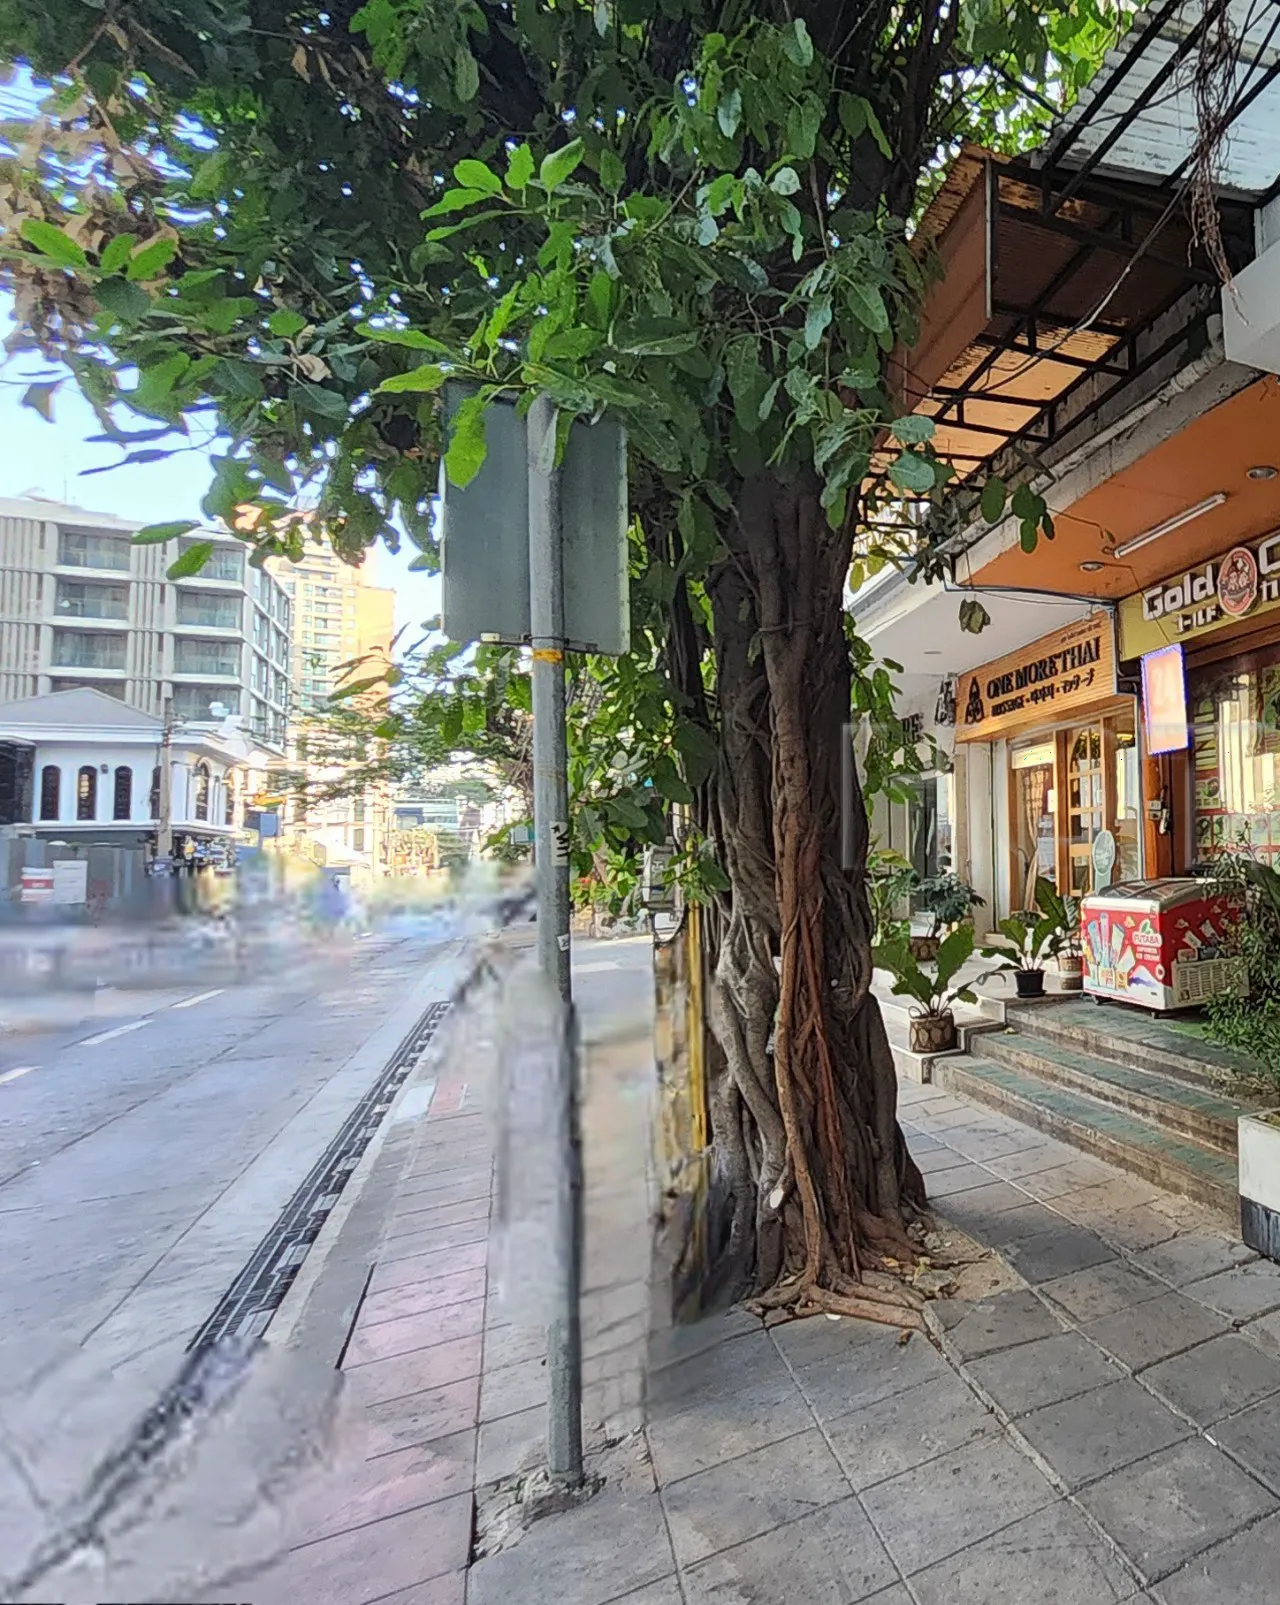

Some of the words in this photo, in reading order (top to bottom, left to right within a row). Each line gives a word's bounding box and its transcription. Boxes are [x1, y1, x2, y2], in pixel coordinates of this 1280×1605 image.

[1142, 564, 1215, 621] Gold
[986, 671, 1015, 699] ONE
[1015, 655, 1058, 692] MORE
[1057, 636, 1101, 673] THAI
